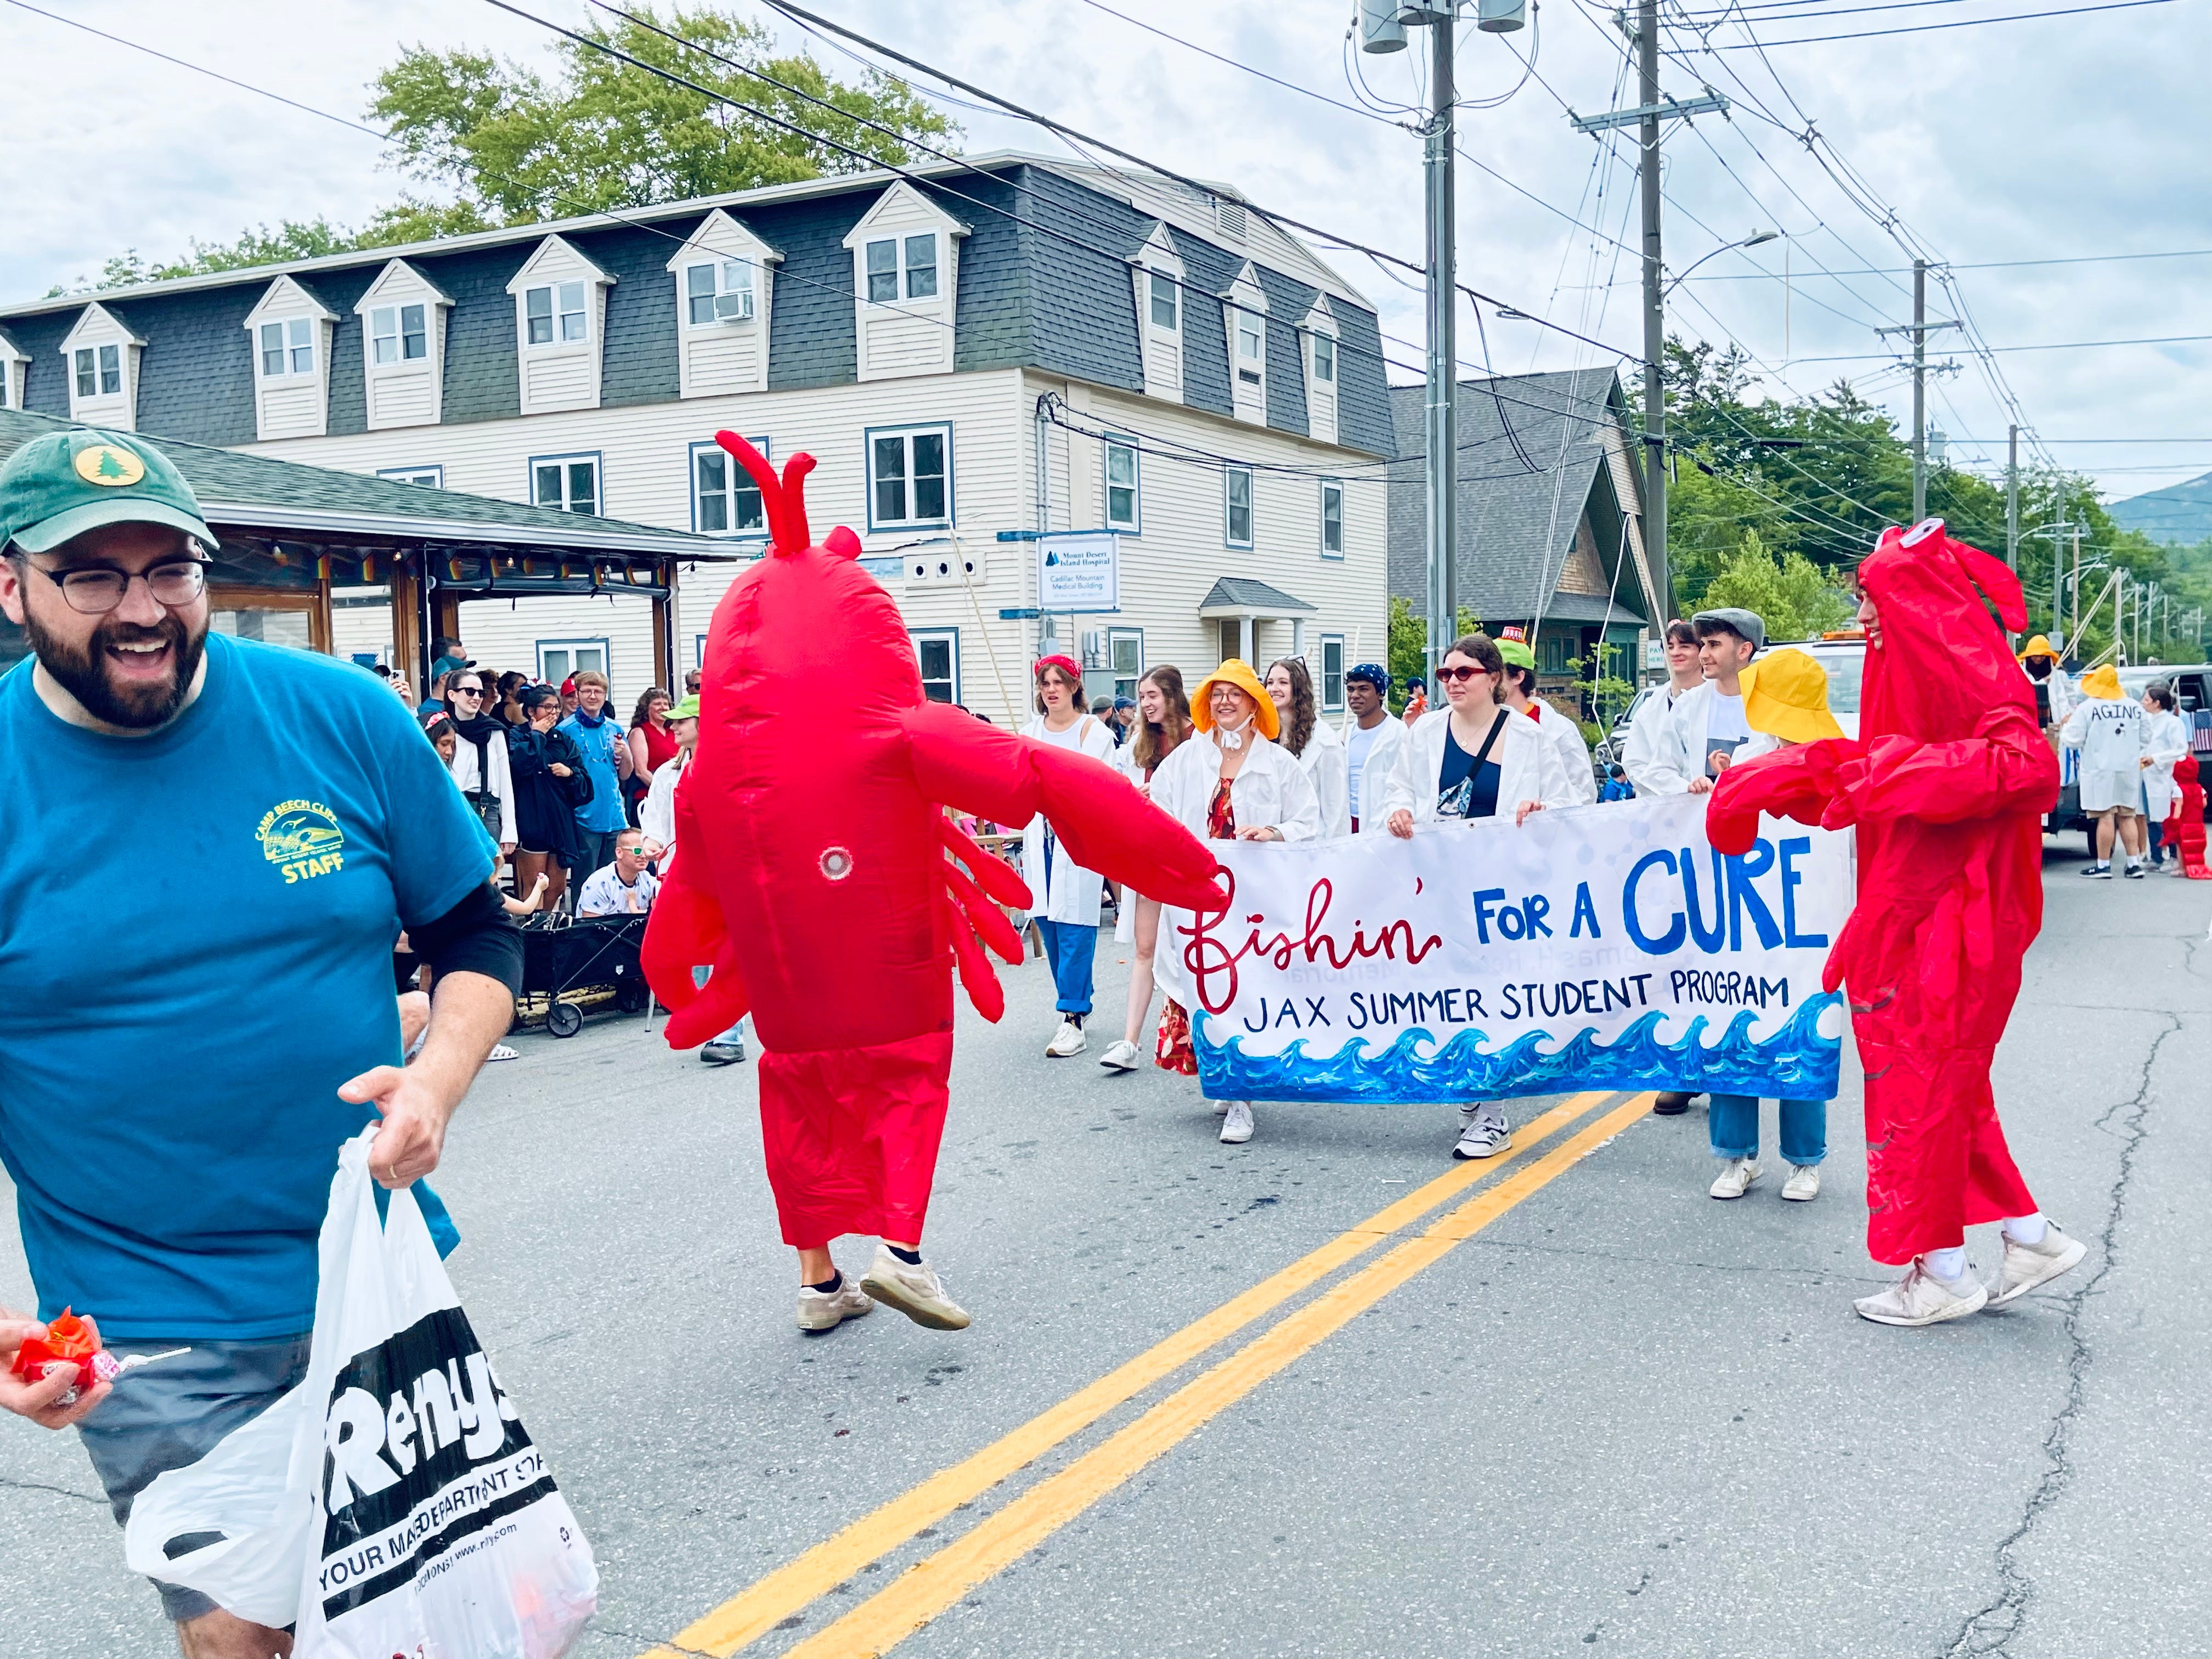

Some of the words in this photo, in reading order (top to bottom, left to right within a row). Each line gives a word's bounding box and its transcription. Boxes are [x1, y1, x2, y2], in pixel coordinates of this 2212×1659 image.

[1082, 558, 1110, 567] Hospital
[2092, 704, 2141, 721] AGING
[255, 811, 275, 841] CAMP
[274, 799, 310, 815] BEECH
[281, 852, 344, 884] STAFF
[1473, 888, 1553, 944] FOR
[1570, 882, 1601, 938] A
[1623, 837, 1829, 955] CURE
[1244, 996, 1330, 1032] JAX
[1347, 989, 1488, 1030] SUMMER
[1500, 974, 1652, 1020] STUDENT
[1671, 969, 1789, 1009] PROGRAM
[319, 1545, 384, 1591] YOUR
